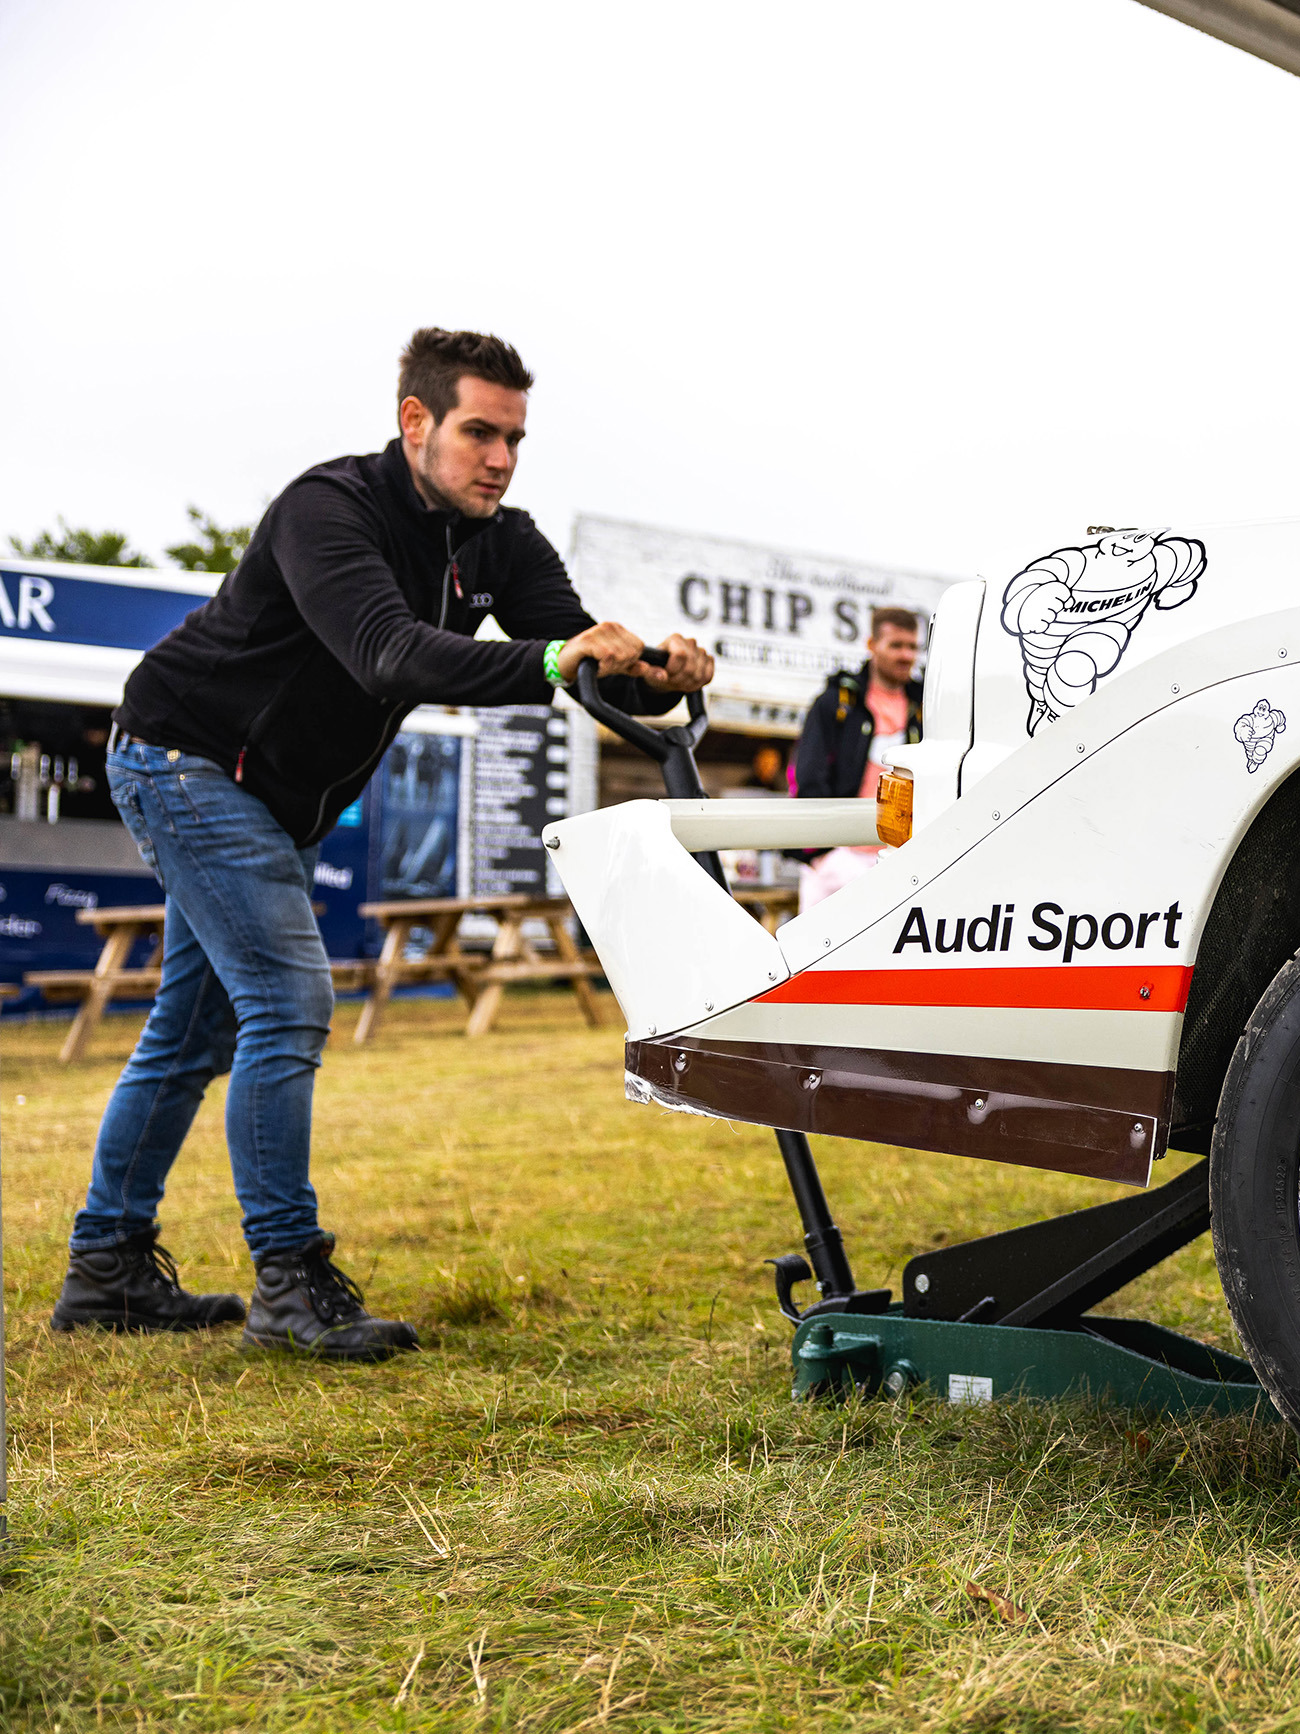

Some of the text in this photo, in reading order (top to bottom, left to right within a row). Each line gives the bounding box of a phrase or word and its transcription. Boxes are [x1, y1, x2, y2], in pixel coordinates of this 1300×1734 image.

[677, 571, 815, 636] CHIP
[1065, 581, 1153, 613] MICHELIN
[892, 900, 1183, 963] Audi Sport
